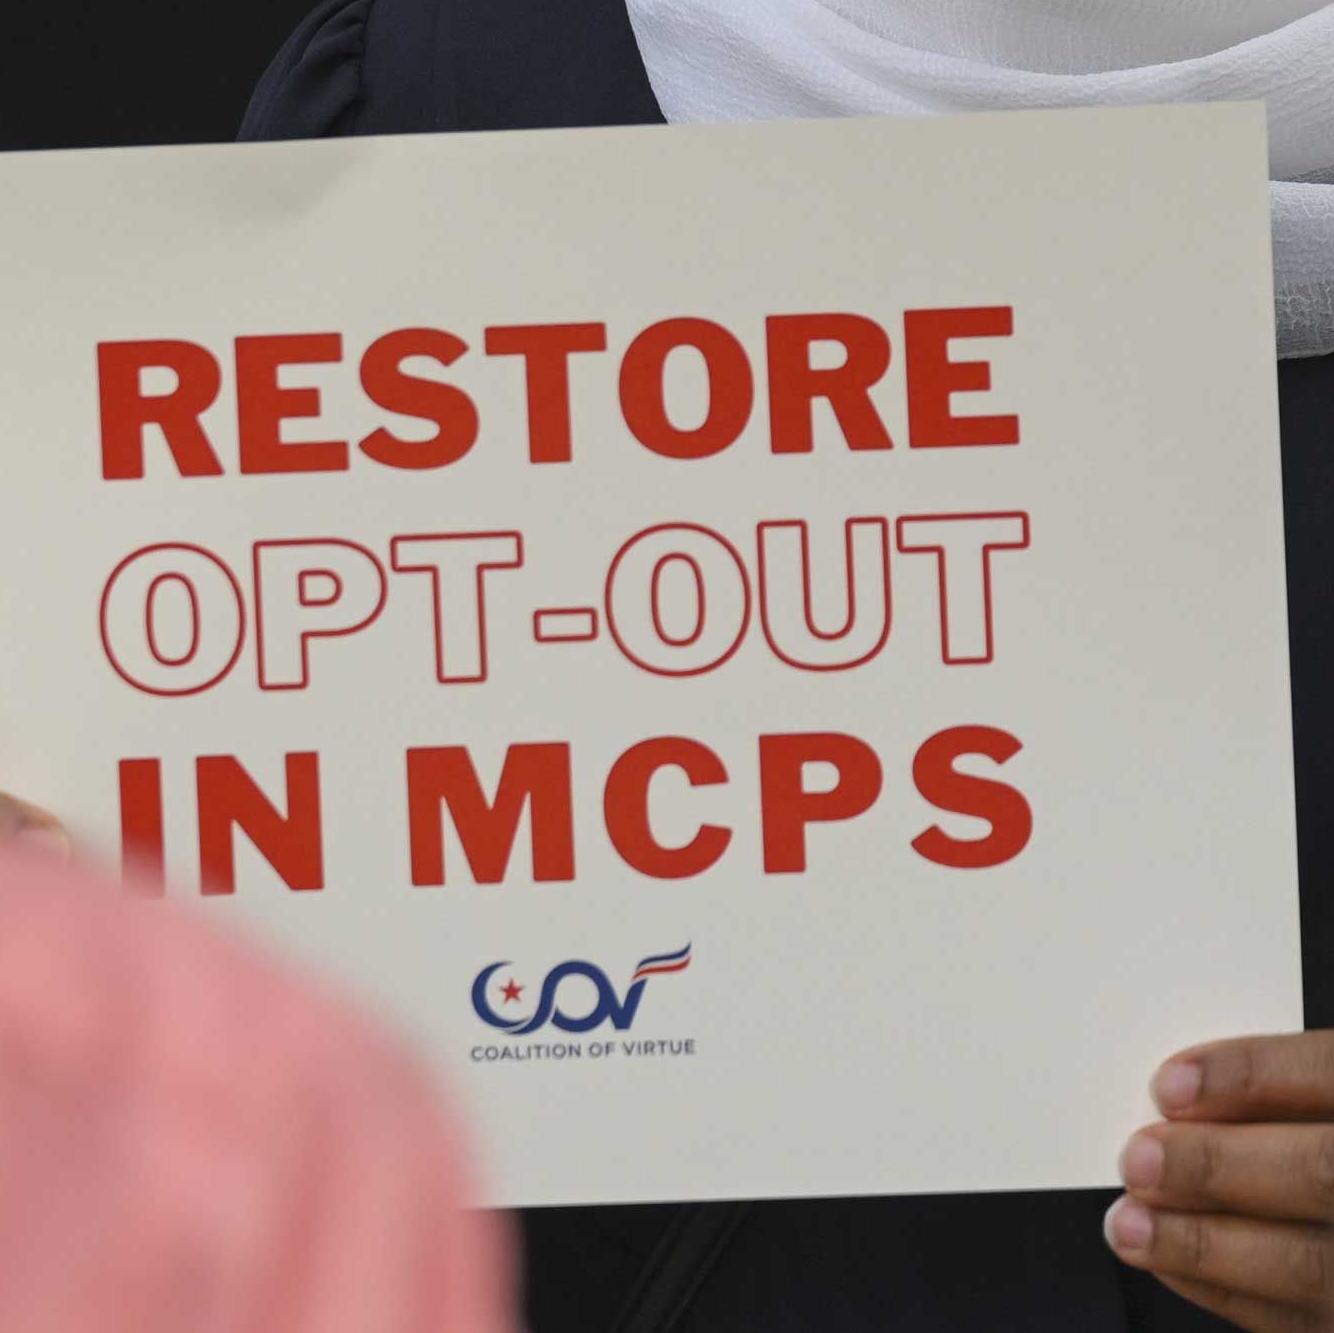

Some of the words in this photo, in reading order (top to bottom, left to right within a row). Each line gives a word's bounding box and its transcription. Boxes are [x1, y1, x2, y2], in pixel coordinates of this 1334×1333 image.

[97, 305, 1021, 482] RESTORE
[99, 511, 1031, 698] OPT-OUT
[118, 751, 325, 897] IN
[405, 724, 1033, 887] MCPS
[470, 1043, 583, 1062] COALITION
[588, 1041, 616, 1058] OF
[622, 1038, 696, 1057] VIRTUE
